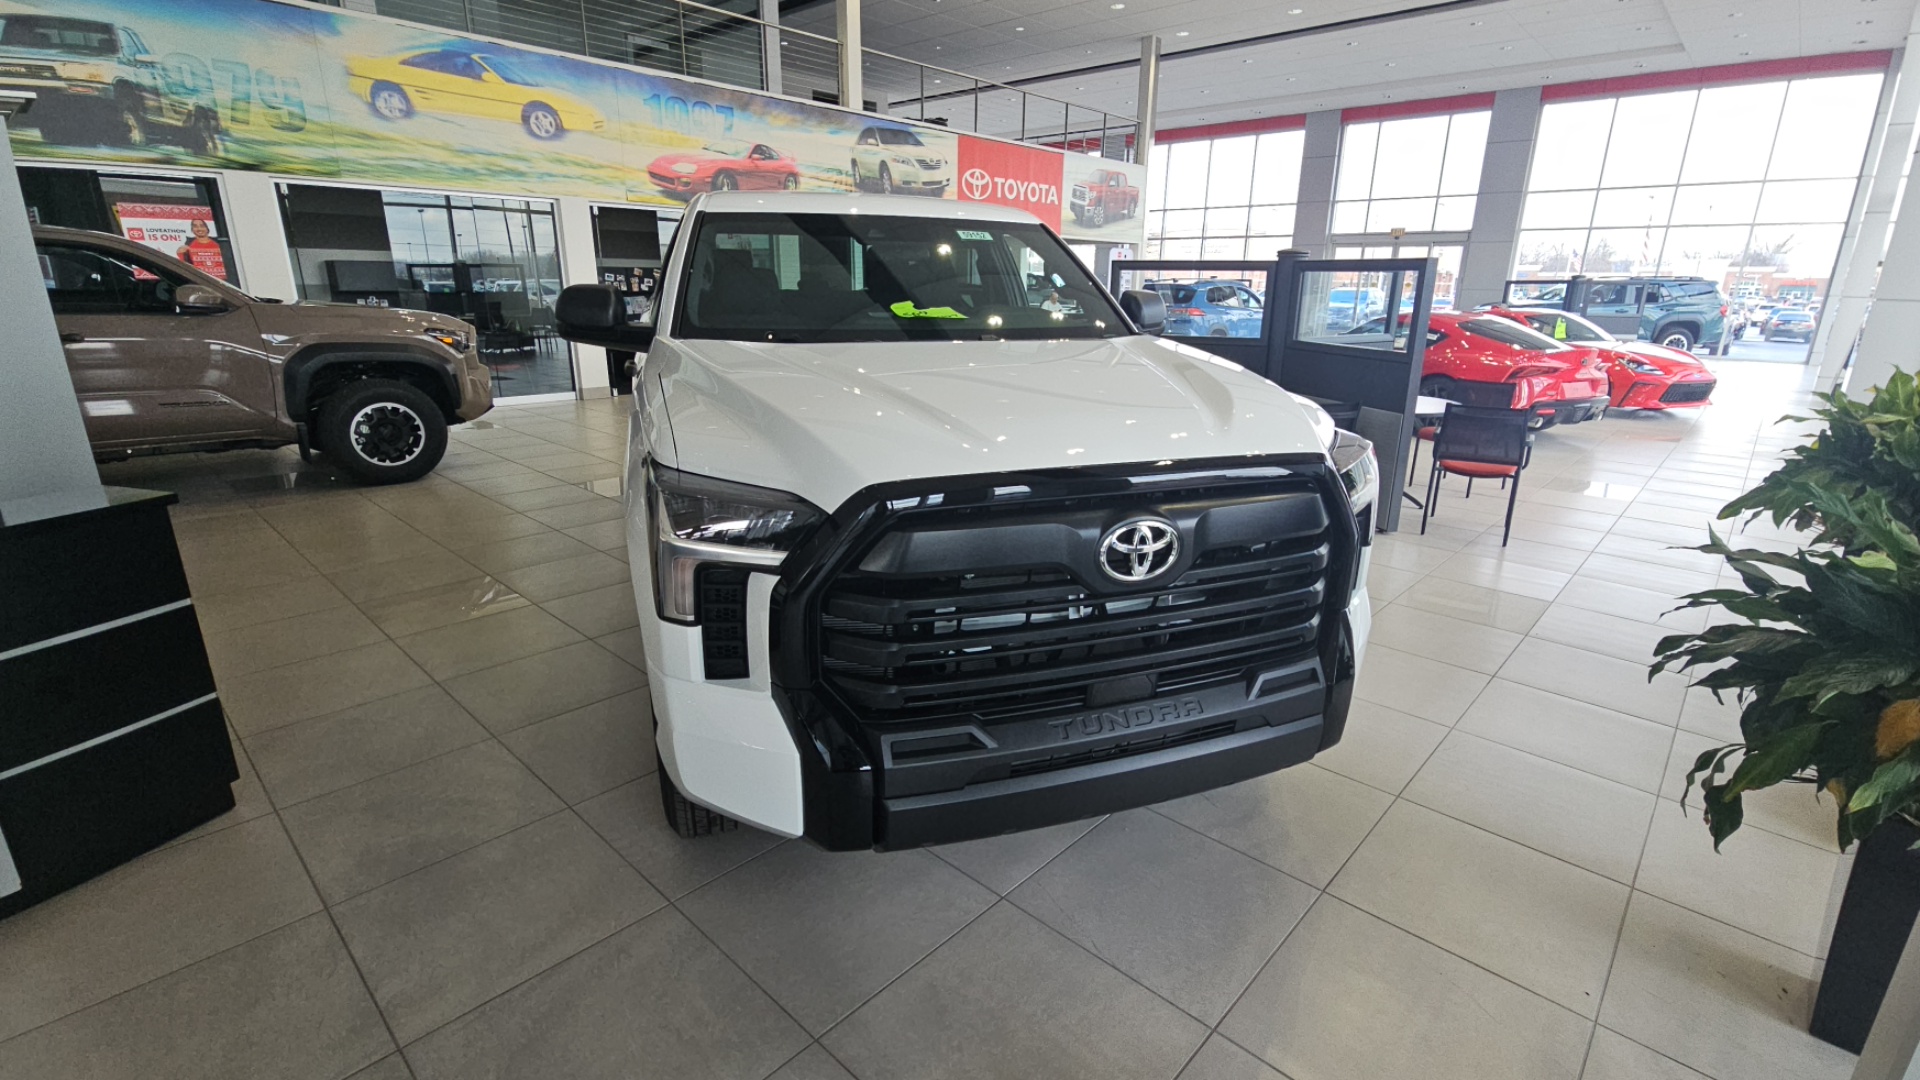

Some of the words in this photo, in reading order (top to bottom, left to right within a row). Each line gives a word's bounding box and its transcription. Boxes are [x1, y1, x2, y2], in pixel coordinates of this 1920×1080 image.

[158, 52, 307, 132] 979
[994, 177, 1058, 205] TOYOTA
[148, 233, 159, 242] IS
[160, 233, 182, 242] ON!
[1048, 696, 1204, 740] TUNDRA
